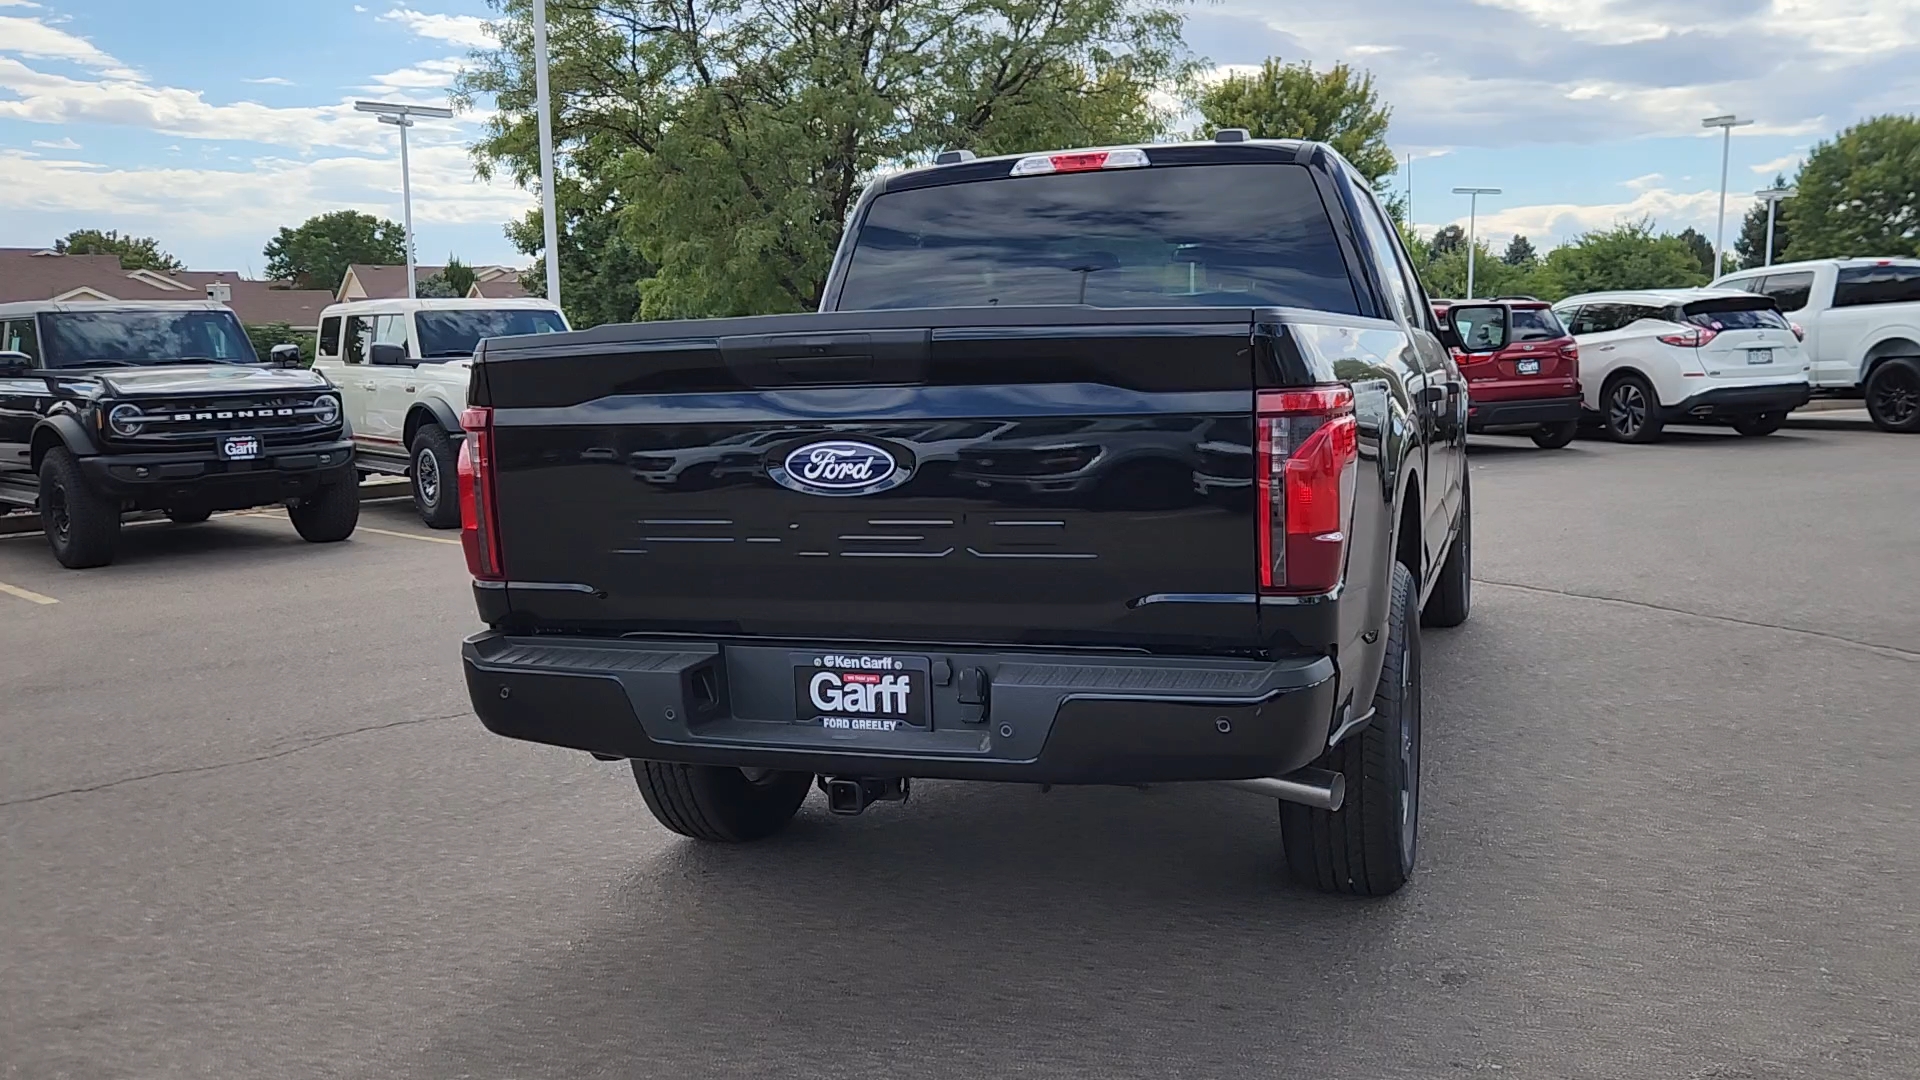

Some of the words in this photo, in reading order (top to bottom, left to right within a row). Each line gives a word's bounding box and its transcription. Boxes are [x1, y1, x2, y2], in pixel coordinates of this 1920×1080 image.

[174, 408, 293, 421] BRONCO
[224, 441, 258, 455] Garff
[803, 448, 874, 480] Ford
[835, 655, 859, 669] Ken
[860, 656, 892, 670] Garff
[809, 671, 910, 714] Garff
[823, 717, 851, 729] FORD
[851, 719, 897, 731] GREELEY
